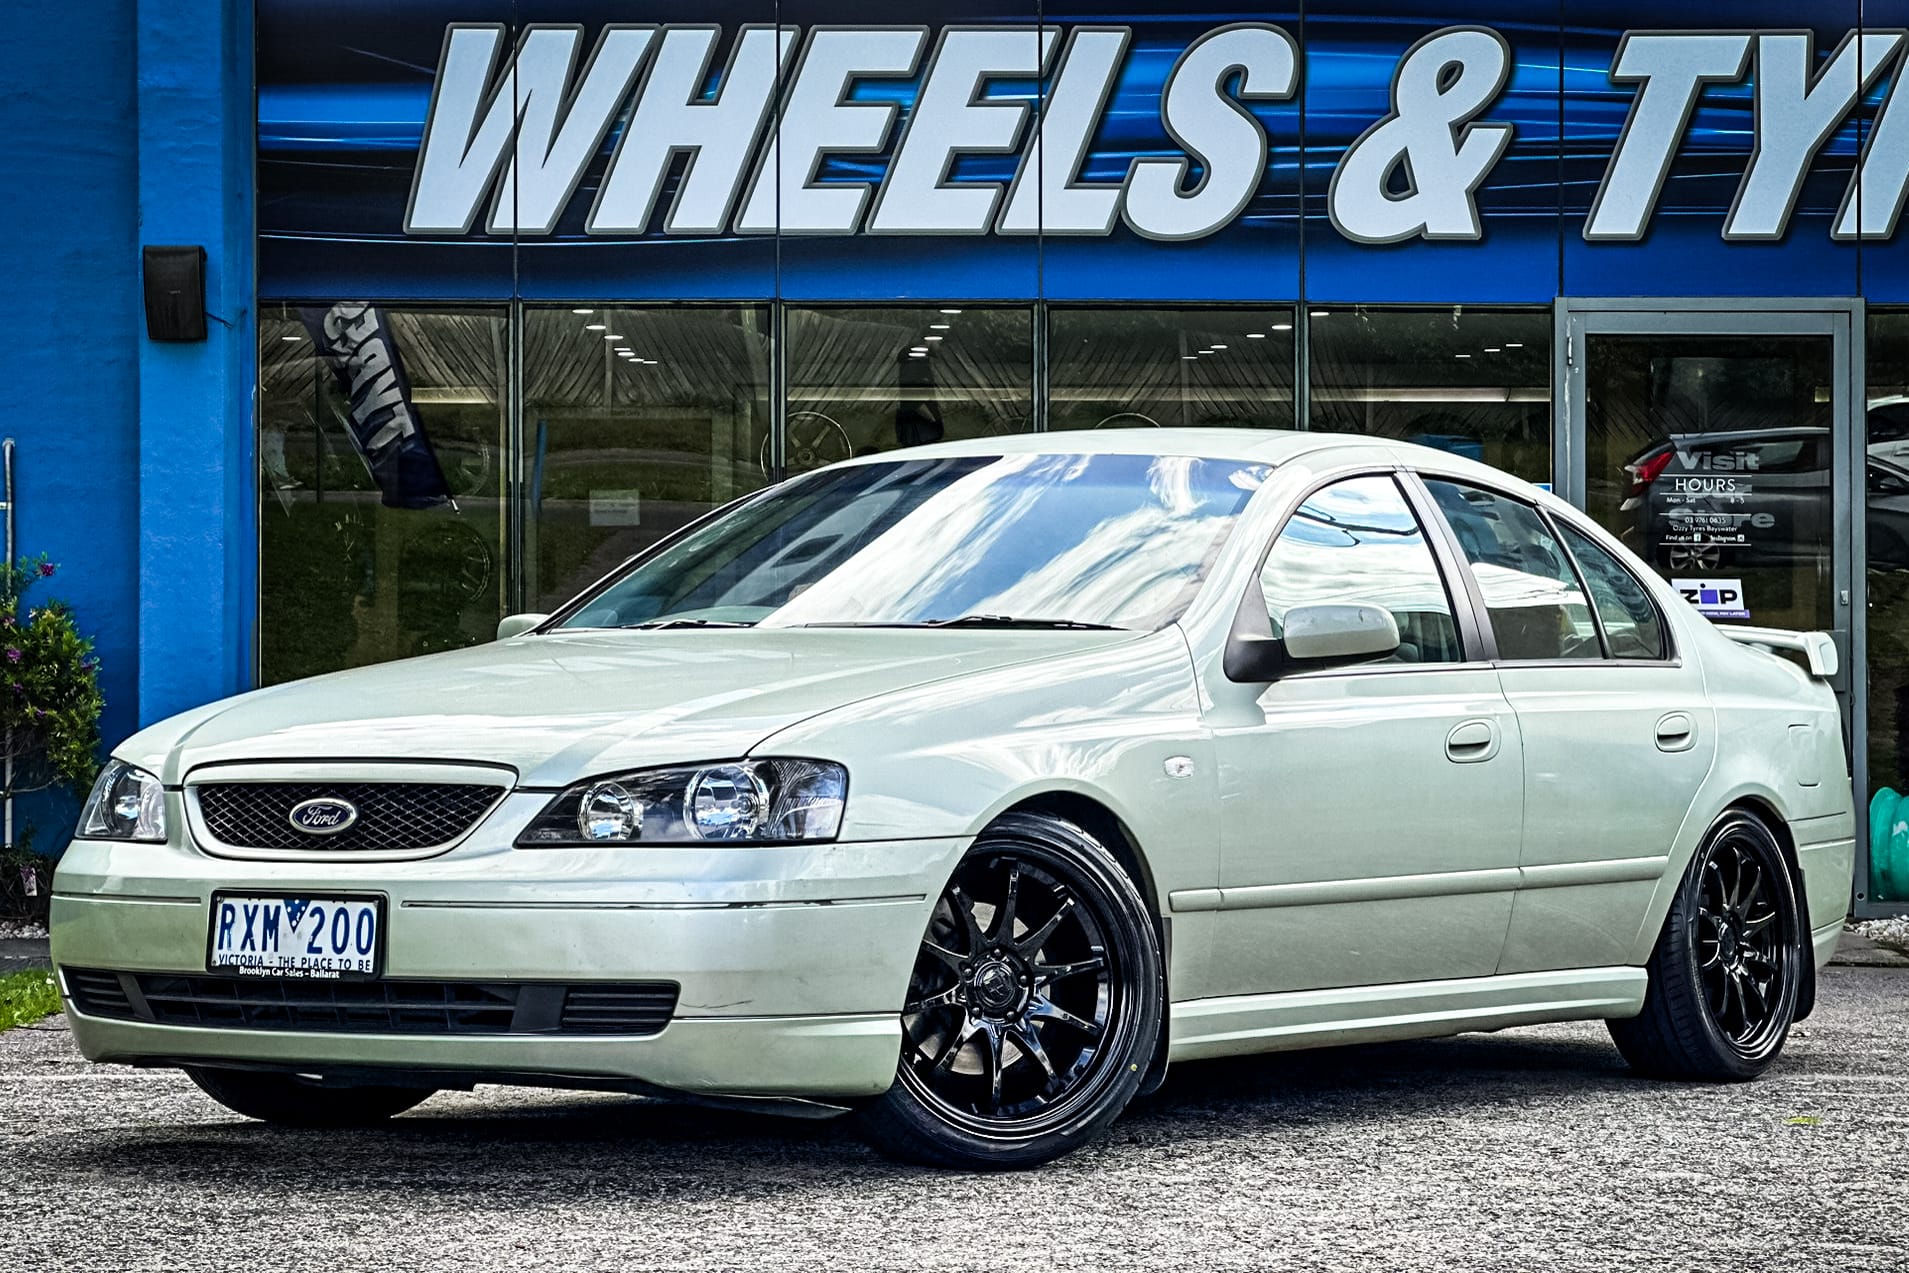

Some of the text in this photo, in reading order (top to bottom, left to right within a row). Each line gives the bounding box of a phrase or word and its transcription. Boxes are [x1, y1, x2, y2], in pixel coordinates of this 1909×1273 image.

[403, 22, 1300, 241] WHEELS
[1327, 24, 1513, 243] &
[1677, 451, 1760, 470] Visit
[1675, 478, 1736, 491] HOURS
[1672, 524, 1738, 533] Ozzy Tyres Bayswater
[1684, 516, 1694, 524] 03
[302, 805, 342, 826] Ford
[218, 903, 375, 956] RXM 200
[218, 953, 264, 967] VICTORIA
[278, 956, 296, 968] THE
[301, 957, 333, 970] PLACE
[338, 958, 352, 970] TO
[358, 959, 371, 971] BE
[239, 966, 271, 977] Brooklyn
[271, 967, 284, 977] Car
[285, 968, 304, 978] Sales
[310, 970, 340, 979] Ballarat
